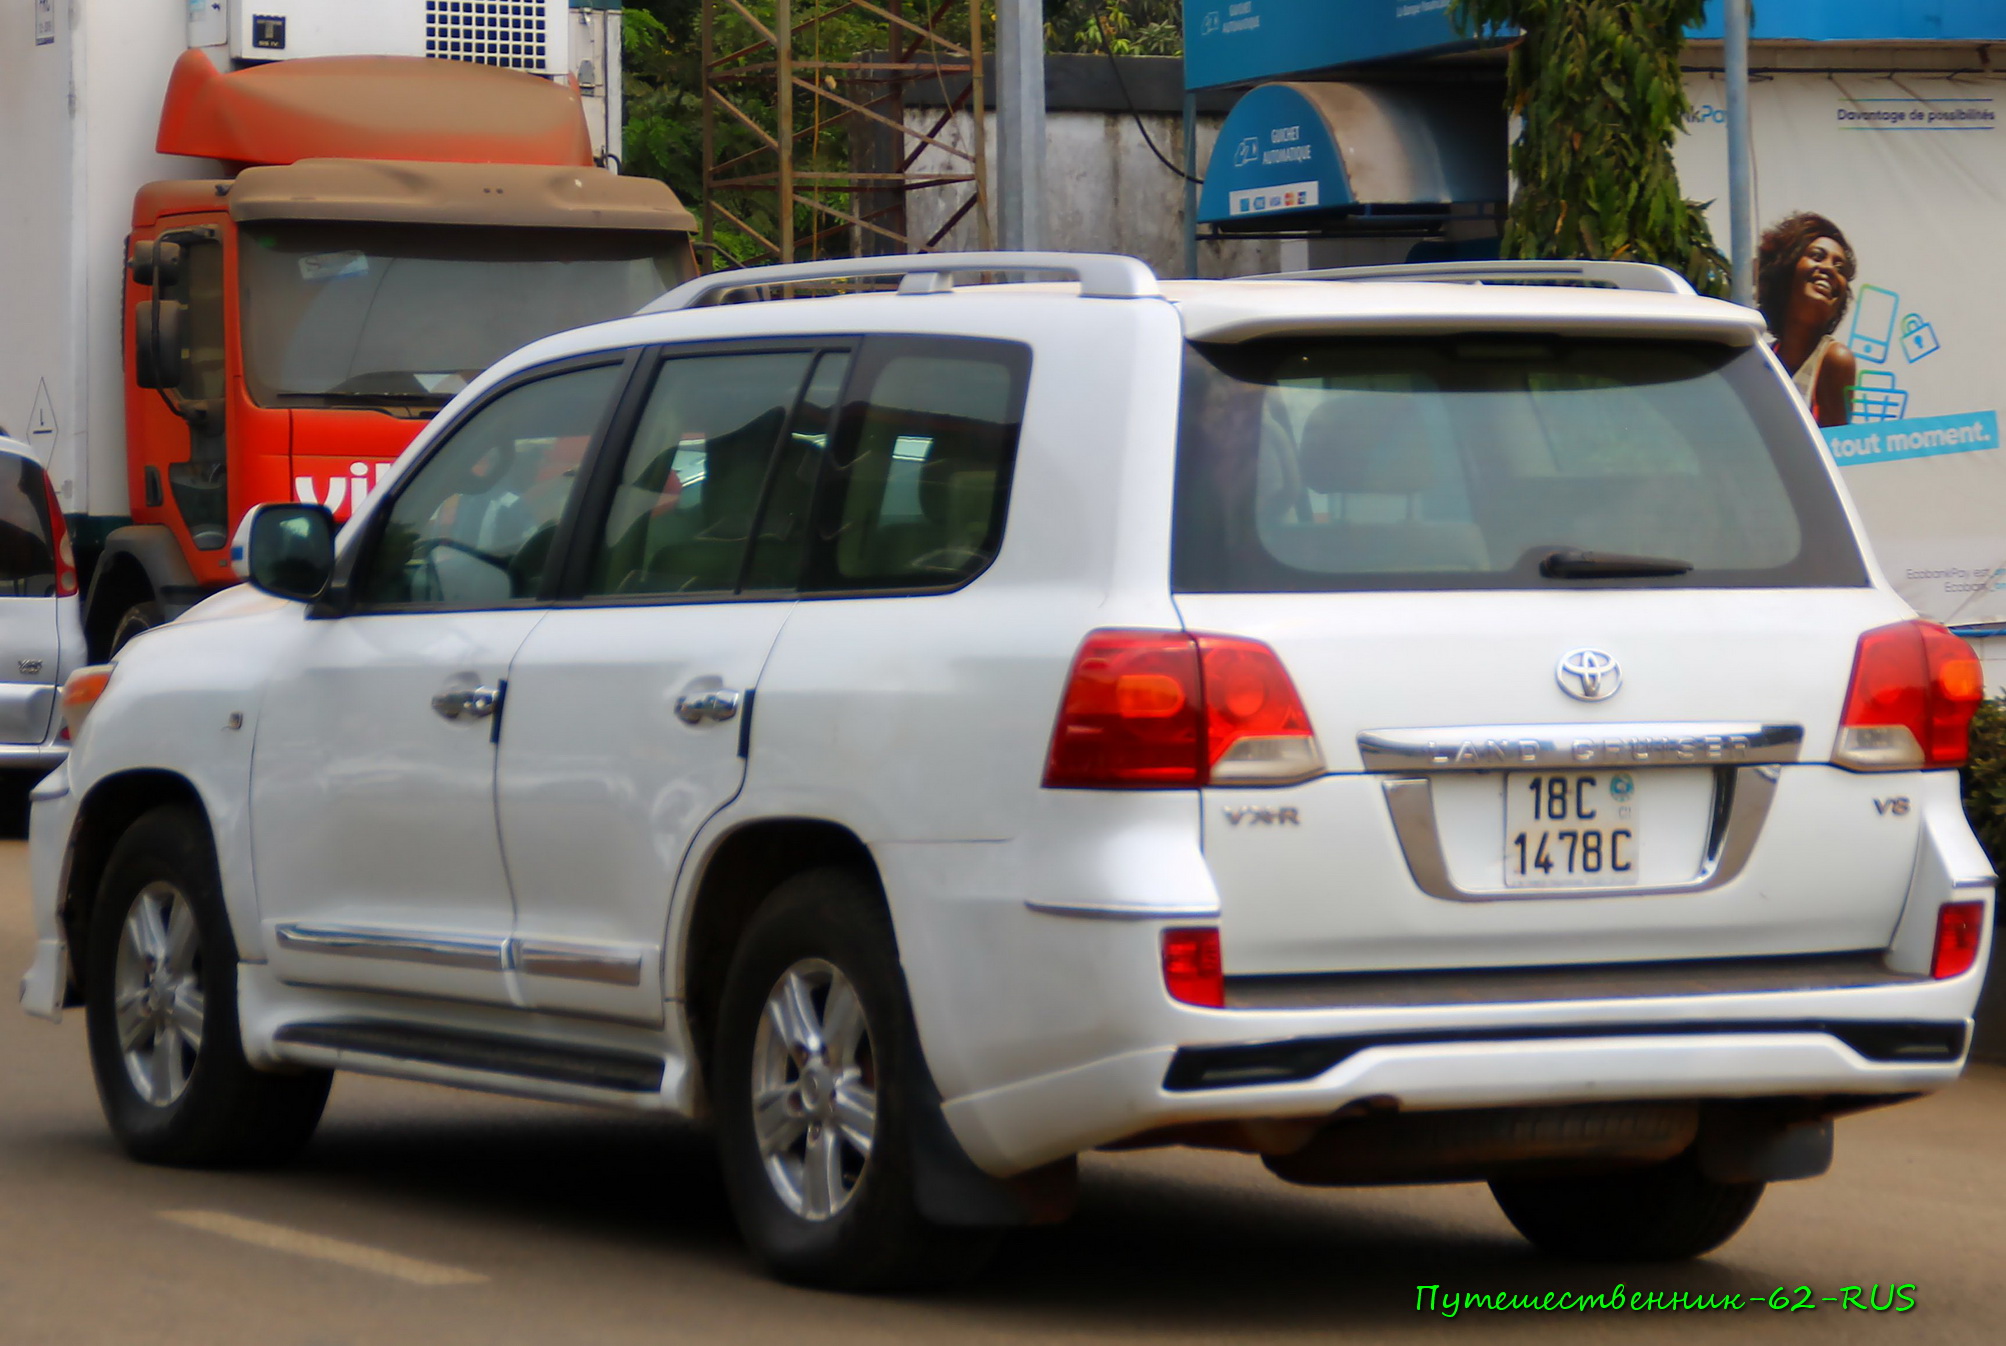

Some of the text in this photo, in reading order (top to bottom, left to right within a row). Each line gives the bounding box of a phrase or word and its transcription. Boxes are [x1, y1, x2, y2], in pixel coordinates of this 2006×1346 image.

[1837, 108, 1995, 123] Davantage de possibilités
[1262, 144, 1311, 165] AUTOMATIQUE
[1831, 421, 1992, 458] tout moment.
[1427, 735, 1751, 764] LAND CRUISER
[1529, 777, 1597, 820] 18C
[1514, 829, 1632, 875] 1478C
